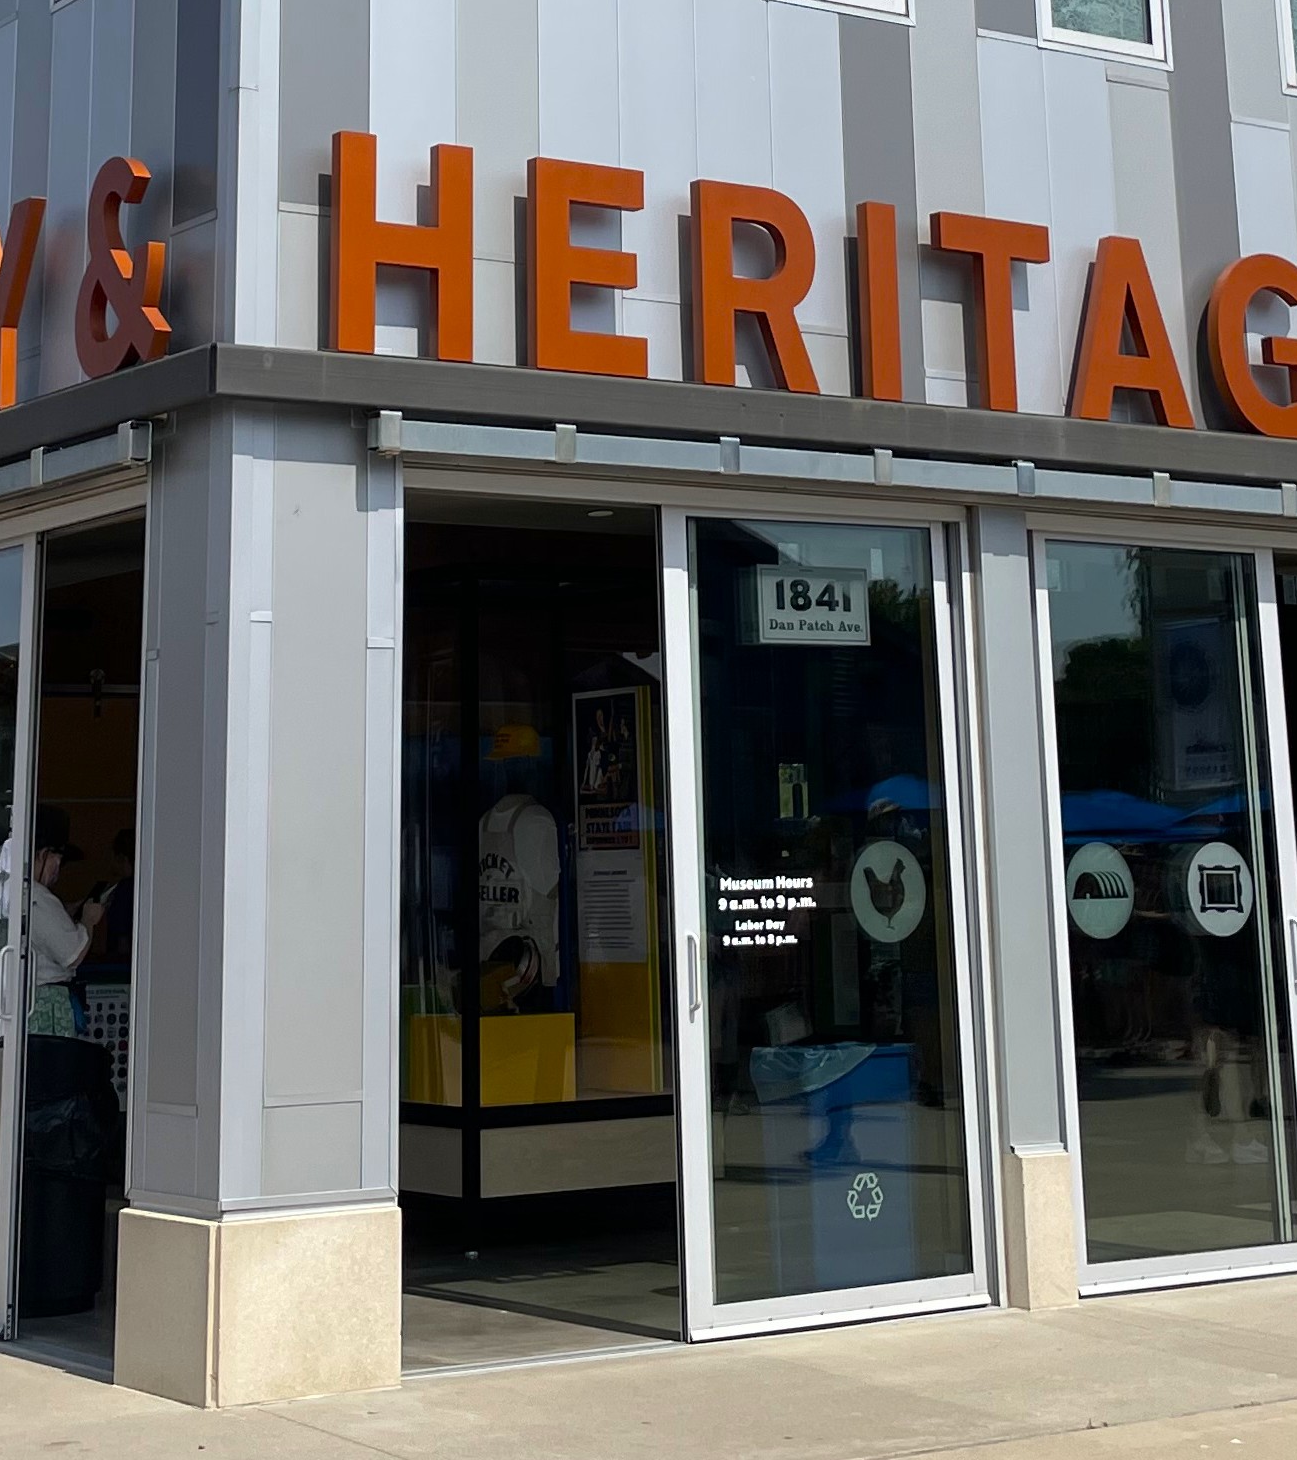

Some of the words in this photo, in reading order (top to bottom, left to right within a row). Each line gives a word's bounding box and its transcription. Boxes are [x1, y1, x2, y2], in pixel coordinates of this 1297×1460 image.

[75, 156, 172, 378] &
[776, 578, 851, 612] 1841
[769, 619, 794, 631] Dan
[798, 619, 834, 632] Patch
[720, 877, 774, 891] Museum
[775, 876, 813, 889] Hours
[479, 885, 520, 903] ELLER
[718, 897, 728, 911] 9
[729, 898, 759, 910] a.m.
[760, 895, 775, 909] to
[776, 894, 786, 909] 9
[787, 897, 817, 910] p.m.
[735, 920, 764, 930] Labor
[765, 919, 785, 930] Day
[723, 935, 730, 946] 9
[731, 936, 754, 946] a.m.
[755, 934, 766, 945] to
[775, 935, 798, 946] p.m.
